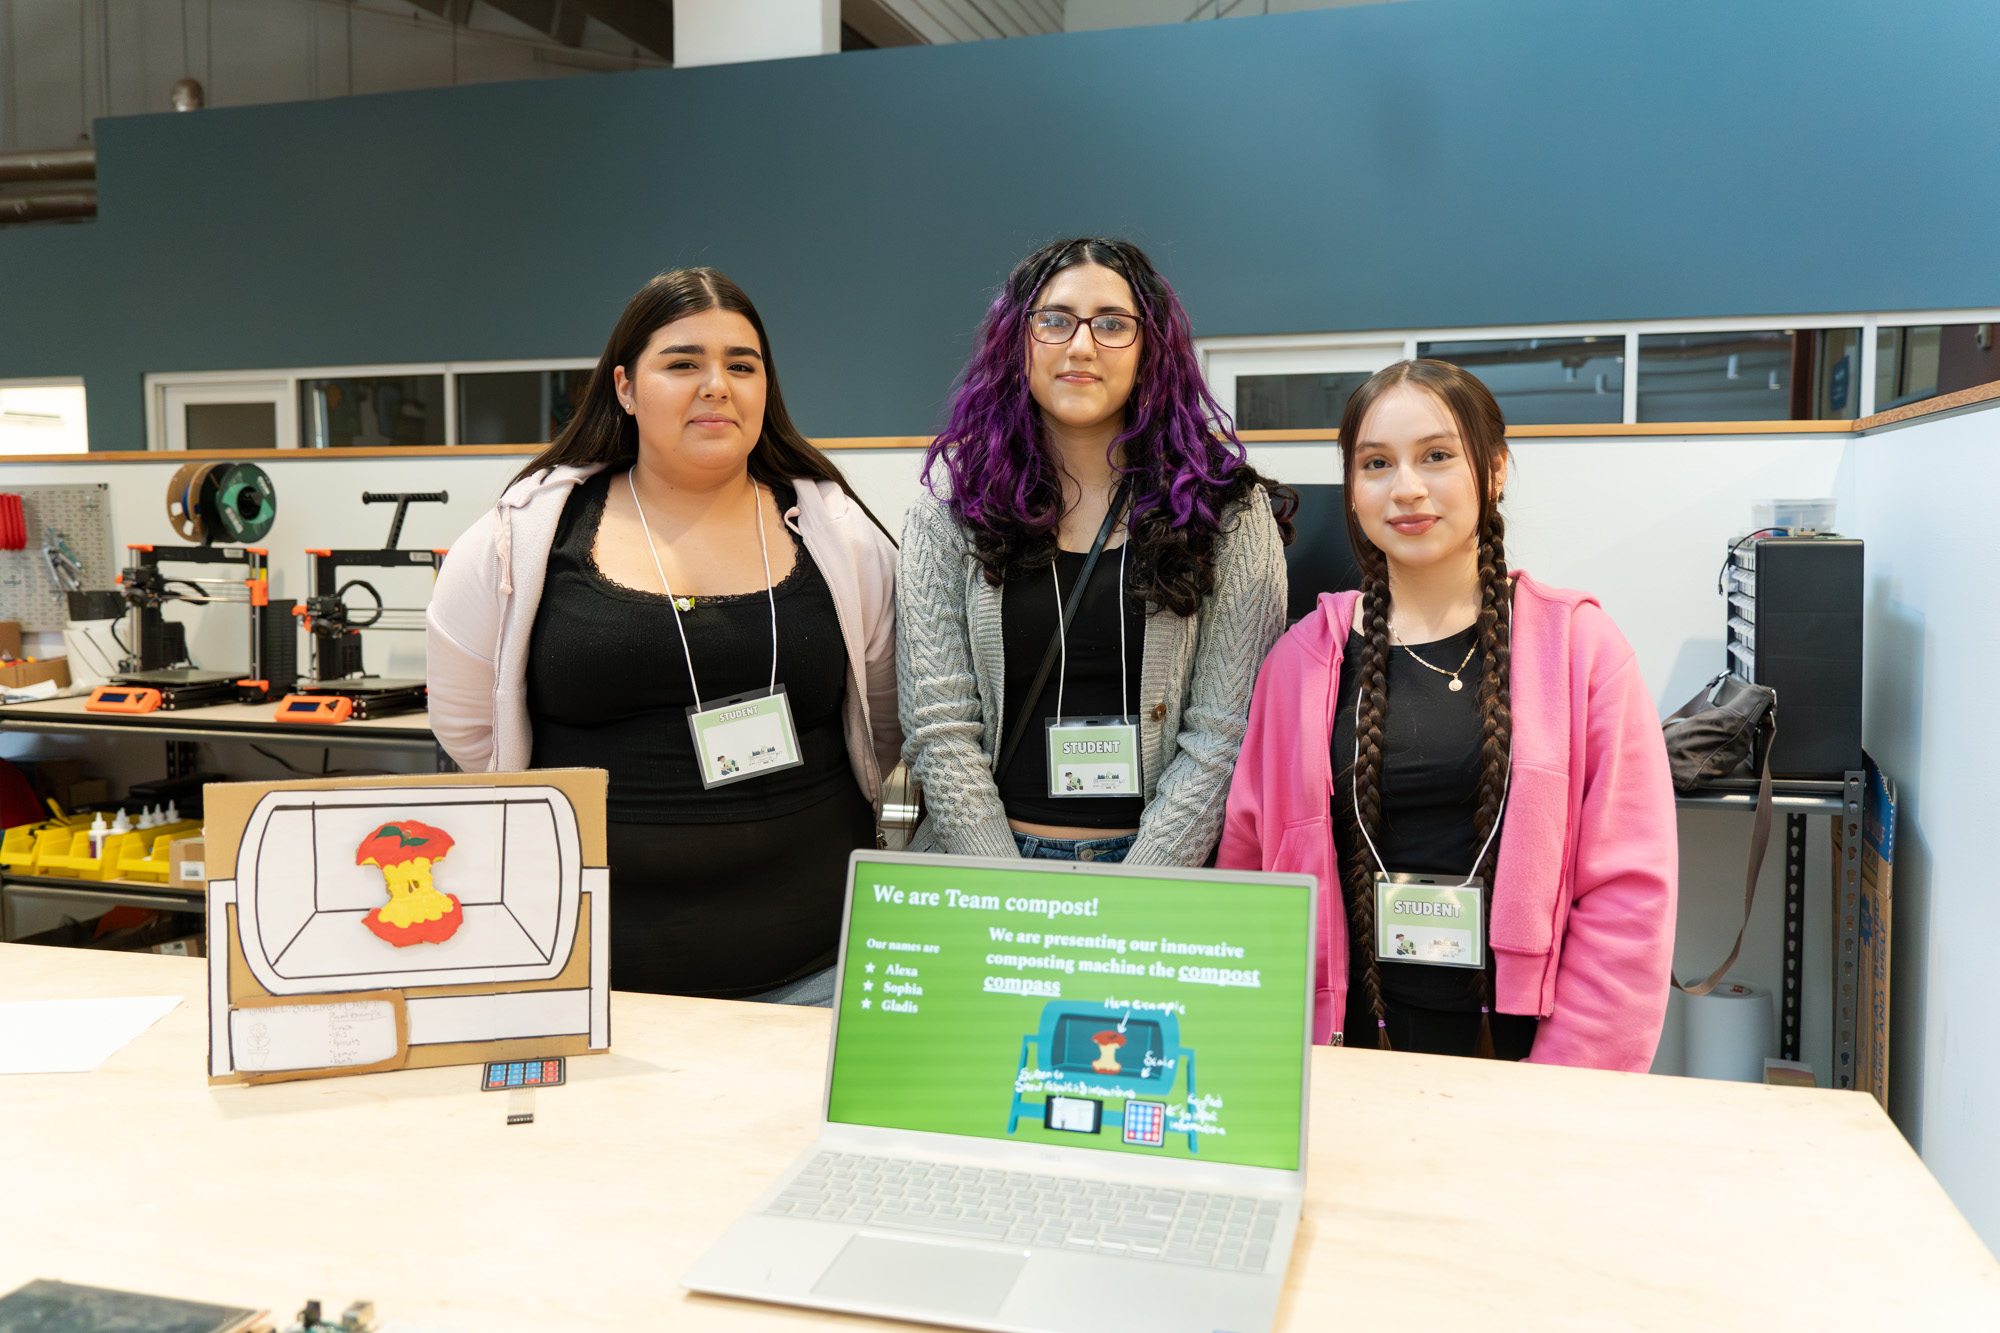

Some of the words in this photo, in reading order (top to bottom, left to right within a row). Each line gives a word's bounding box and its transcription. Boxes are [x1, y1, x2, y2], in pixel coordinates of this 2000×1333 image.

[719, 705, 759, 723] STUDENT
[1063, 740, 1121, 754] STUDENT
[873, 884, 904, 904] We
[908, 890, 940, 906] are
[945, 888, 1000, 910] Team
[1005, 897, 1099, 919] compost!
[1393, 900, 1463, 918] STUDENT
[866, 938, 886, 951] Our
[888, 941, 921, 952] names
[923, 943, 940, 954] are
[989, 927, 1013, 942] We
[1016, 930, 1041, 944] are
[1044, 933, 1126, 954] presenting
[1129, 942, 1158, 953] our
[1160, 938, 1244, 959] innovative
[885, 964, 918, 977] Alexa
[986, 953, 1075, 974] composting
[1078, 958, 1145, 976] machine
[1149, 961, 1175, 978] the
[1177, 965, 1261, 987] compost
[883, 981, 923, 997] Sophia
[983, 976, 1061, 997] compass
[881, 999, 918, 1013] Gladis
